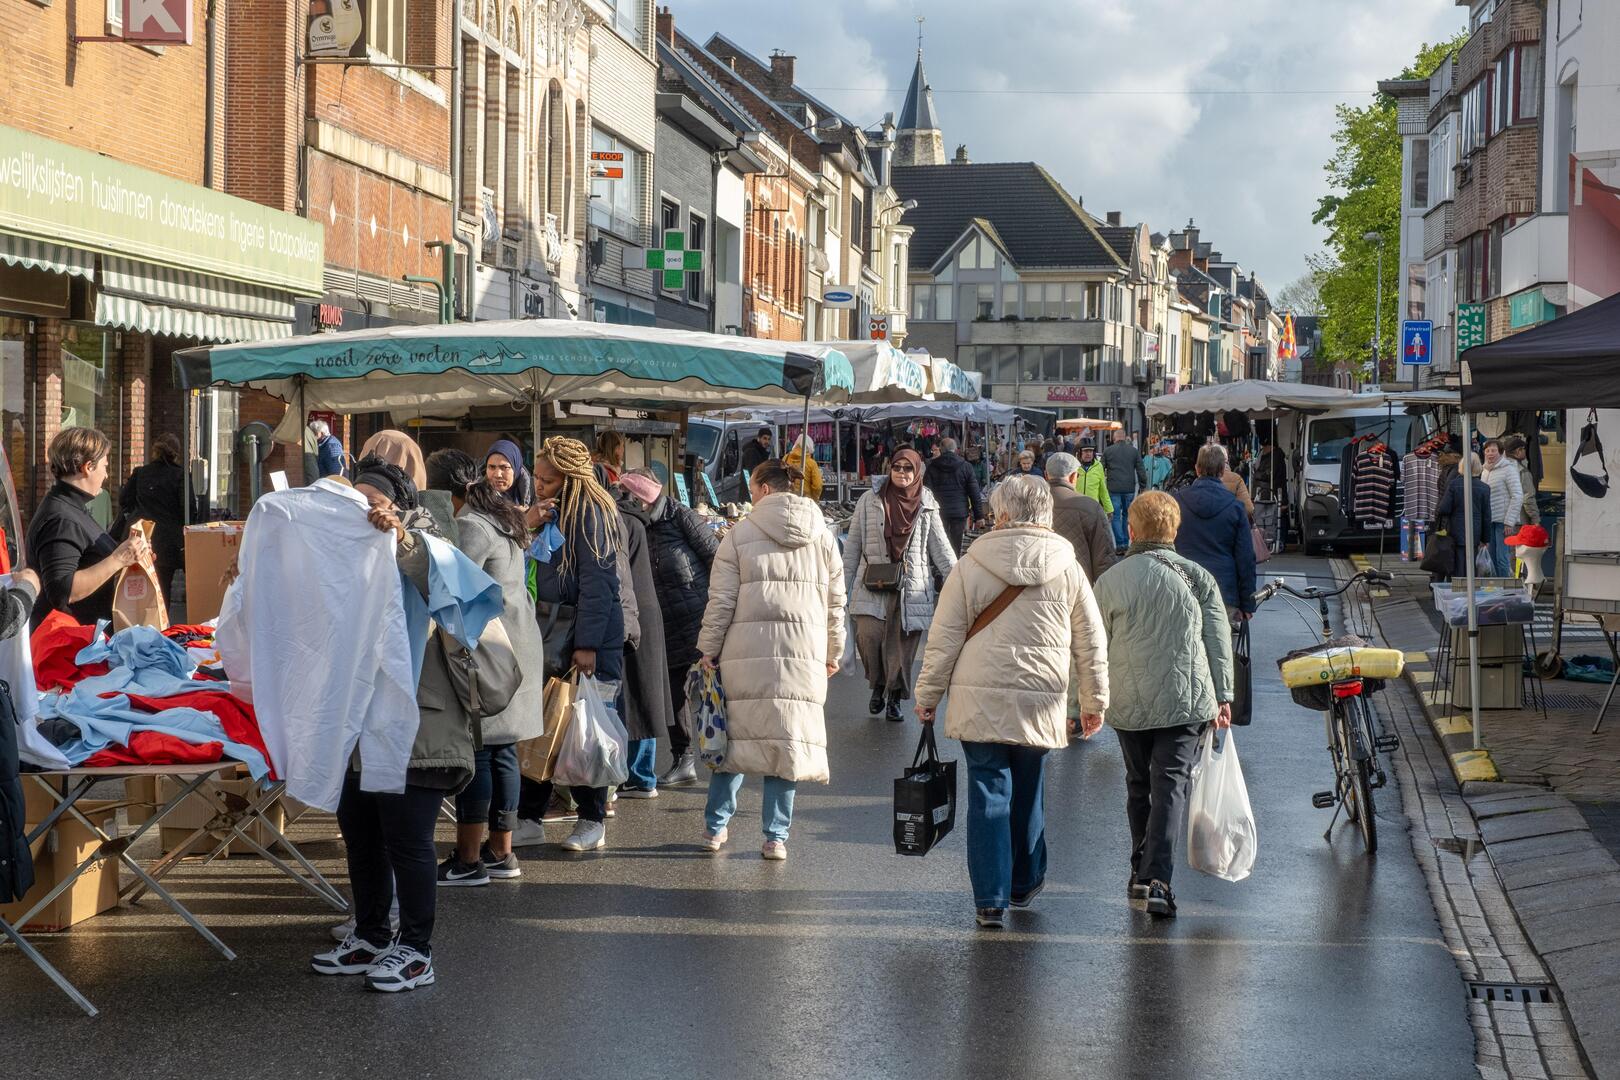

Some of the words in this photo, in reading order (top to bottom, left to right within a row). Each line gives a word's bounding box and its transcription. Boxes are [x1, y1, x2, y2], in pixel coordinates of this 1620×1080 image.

[91, 171, 153, 221] huislinnen
[159, 192, 225, 240] donsdekens
[230, 211, 265, 253] lingerie
[269, 223, 320, 264] badpakken
[320, 304, 343, 327] PRIMUS
[1470, 306, 1484, 346] WINK
[315, 347, 359, 368] nooit
[366, 352, 402, 366] zere
[409, 344, 461, 364] voeten
